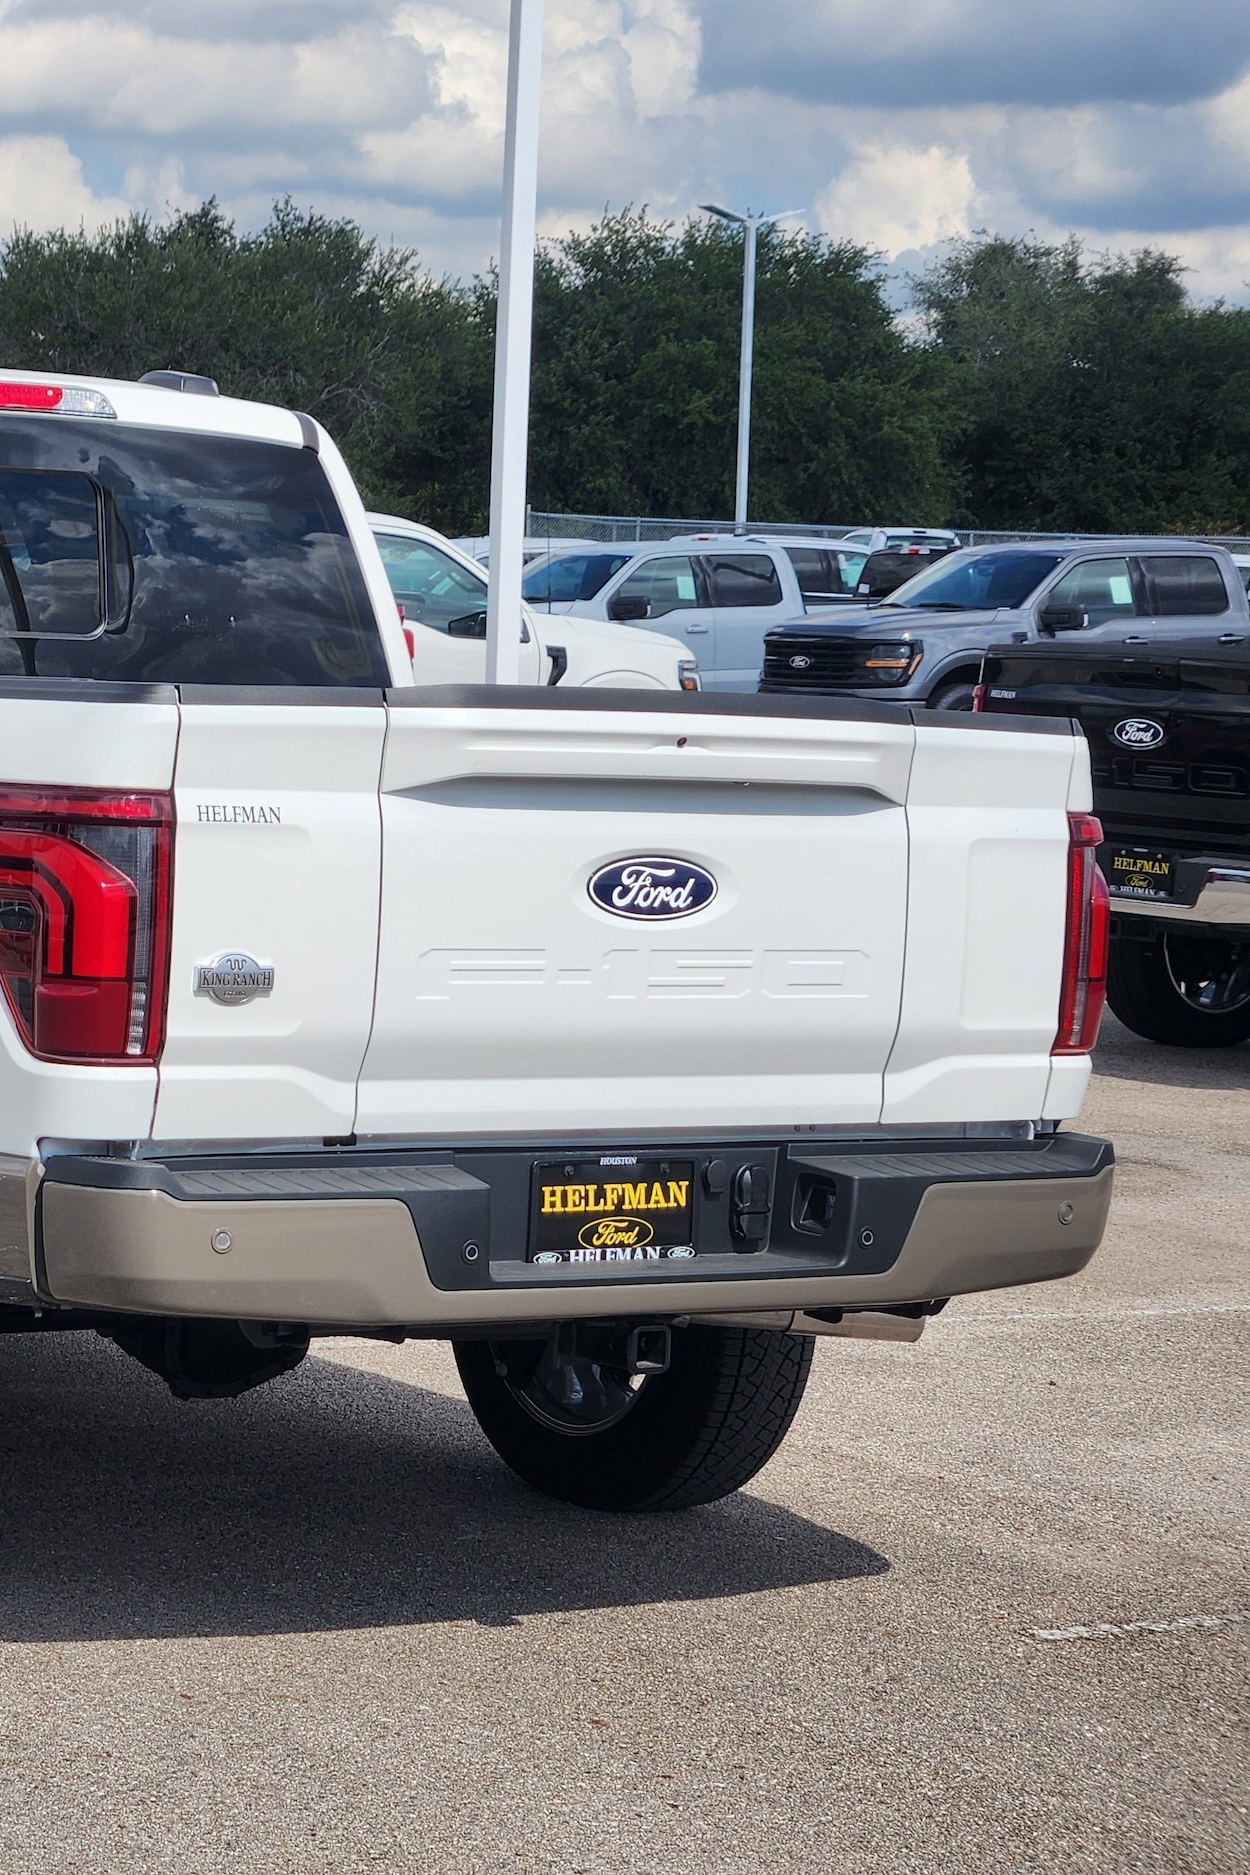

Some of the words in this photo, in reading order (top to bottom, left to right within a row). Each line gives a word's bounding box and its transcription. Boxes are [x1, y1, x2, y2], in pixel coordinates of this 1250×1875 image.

[1121, 721, 1154, 743] Ford
[1094, 757, 1247, 797] -150
[196, 804, 282, 824] HELFMAN
[1112, 856, 1171, 875] HELFMAN
[612, 865, 696, 909] Ford
[1129, 875, 1150, 888] Ford
[202, 970, 230, 987] KING
[232, 971, 272, 987] RANCH
[415, 948, 871, 1000] F-150
[600, 1156, 638, 1166] HOUSTON
[541, 1181, 690, 1213] HELFMAN
[592, 1221, 640, 1247] Ford
